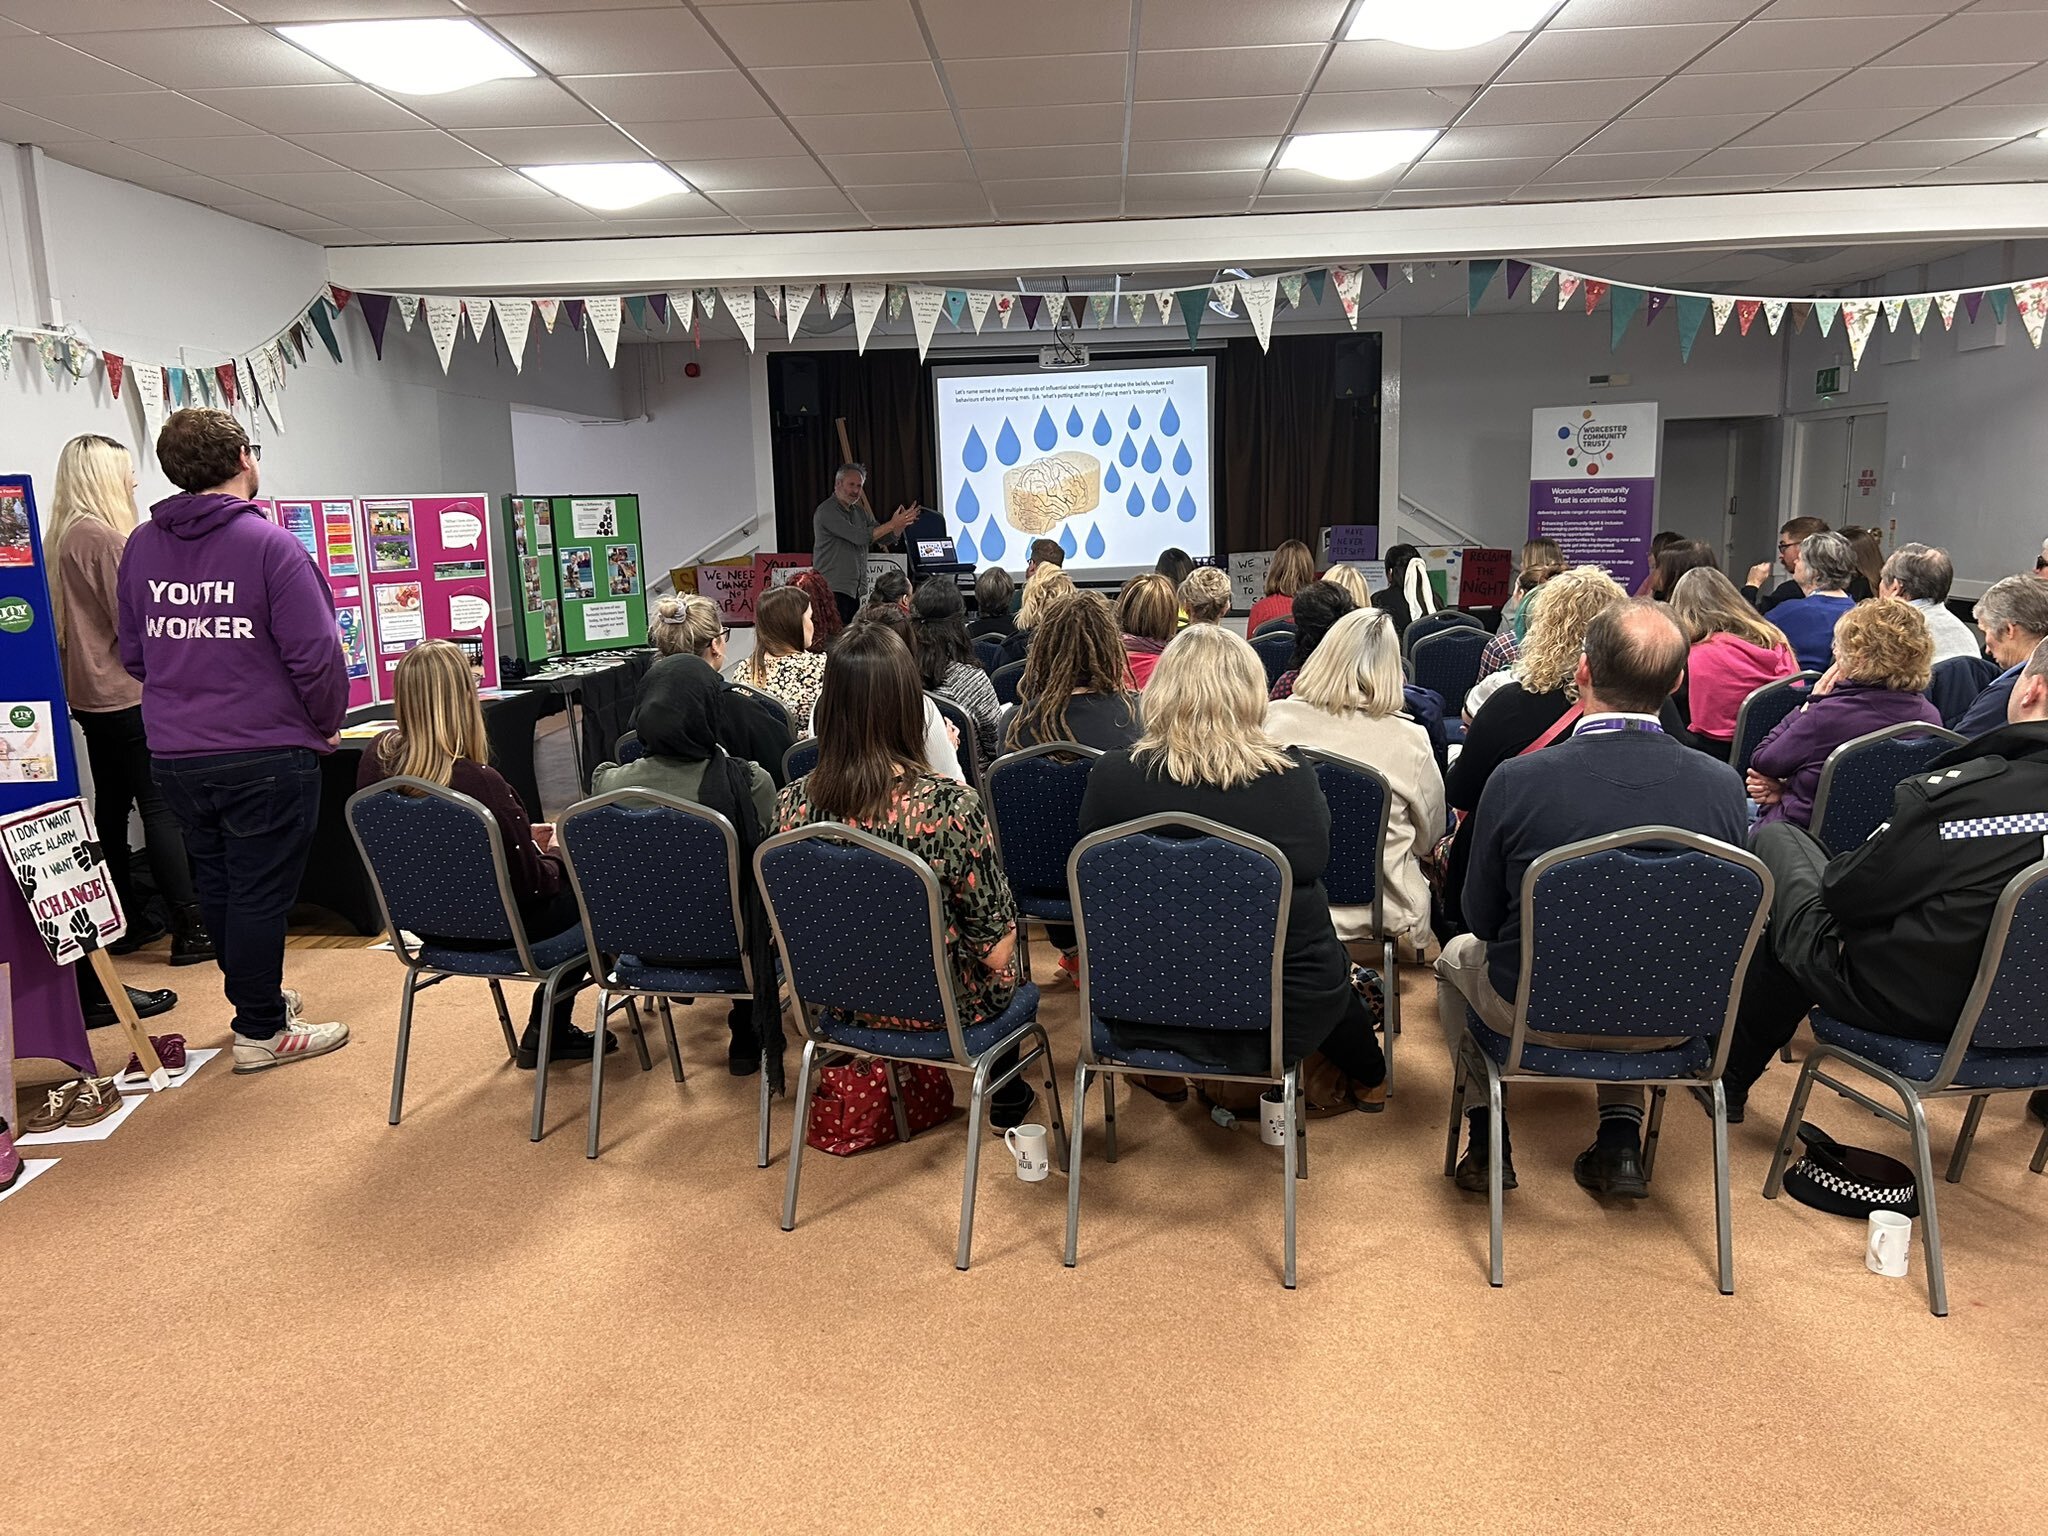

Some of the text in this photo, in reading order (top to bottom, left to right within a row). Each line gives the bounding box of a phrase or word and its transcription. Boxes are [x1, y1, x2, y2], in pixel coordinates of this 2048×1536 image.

[1337, 537, 1363, 546] NEVER
[1471, 550, 1509, 561] RECLAIM
[1238, 558, 1255, 568] WE
[704, 570, 720, 580] WE
[1477, 566, 1496, 576] THE
[1237, 574, 1253, 583] THE
[716, 580, 753, 590] CHANGE
[1463, 578, 1506, 596] NIGHT
[148, 579, 235, 606] YOUTH
[729, 588, 746, 598] NOT
[145, 615, 255, 640] WORKER
[10, 810, 72, 843] I DON'T WANT
[14, 829, 78, 864] A RAPE ALARM
[41, 856, 75, 879] I WANT
[38, 878, 106, 920] CHANGE
[1019, 1161, 1032, 1169] HUB
